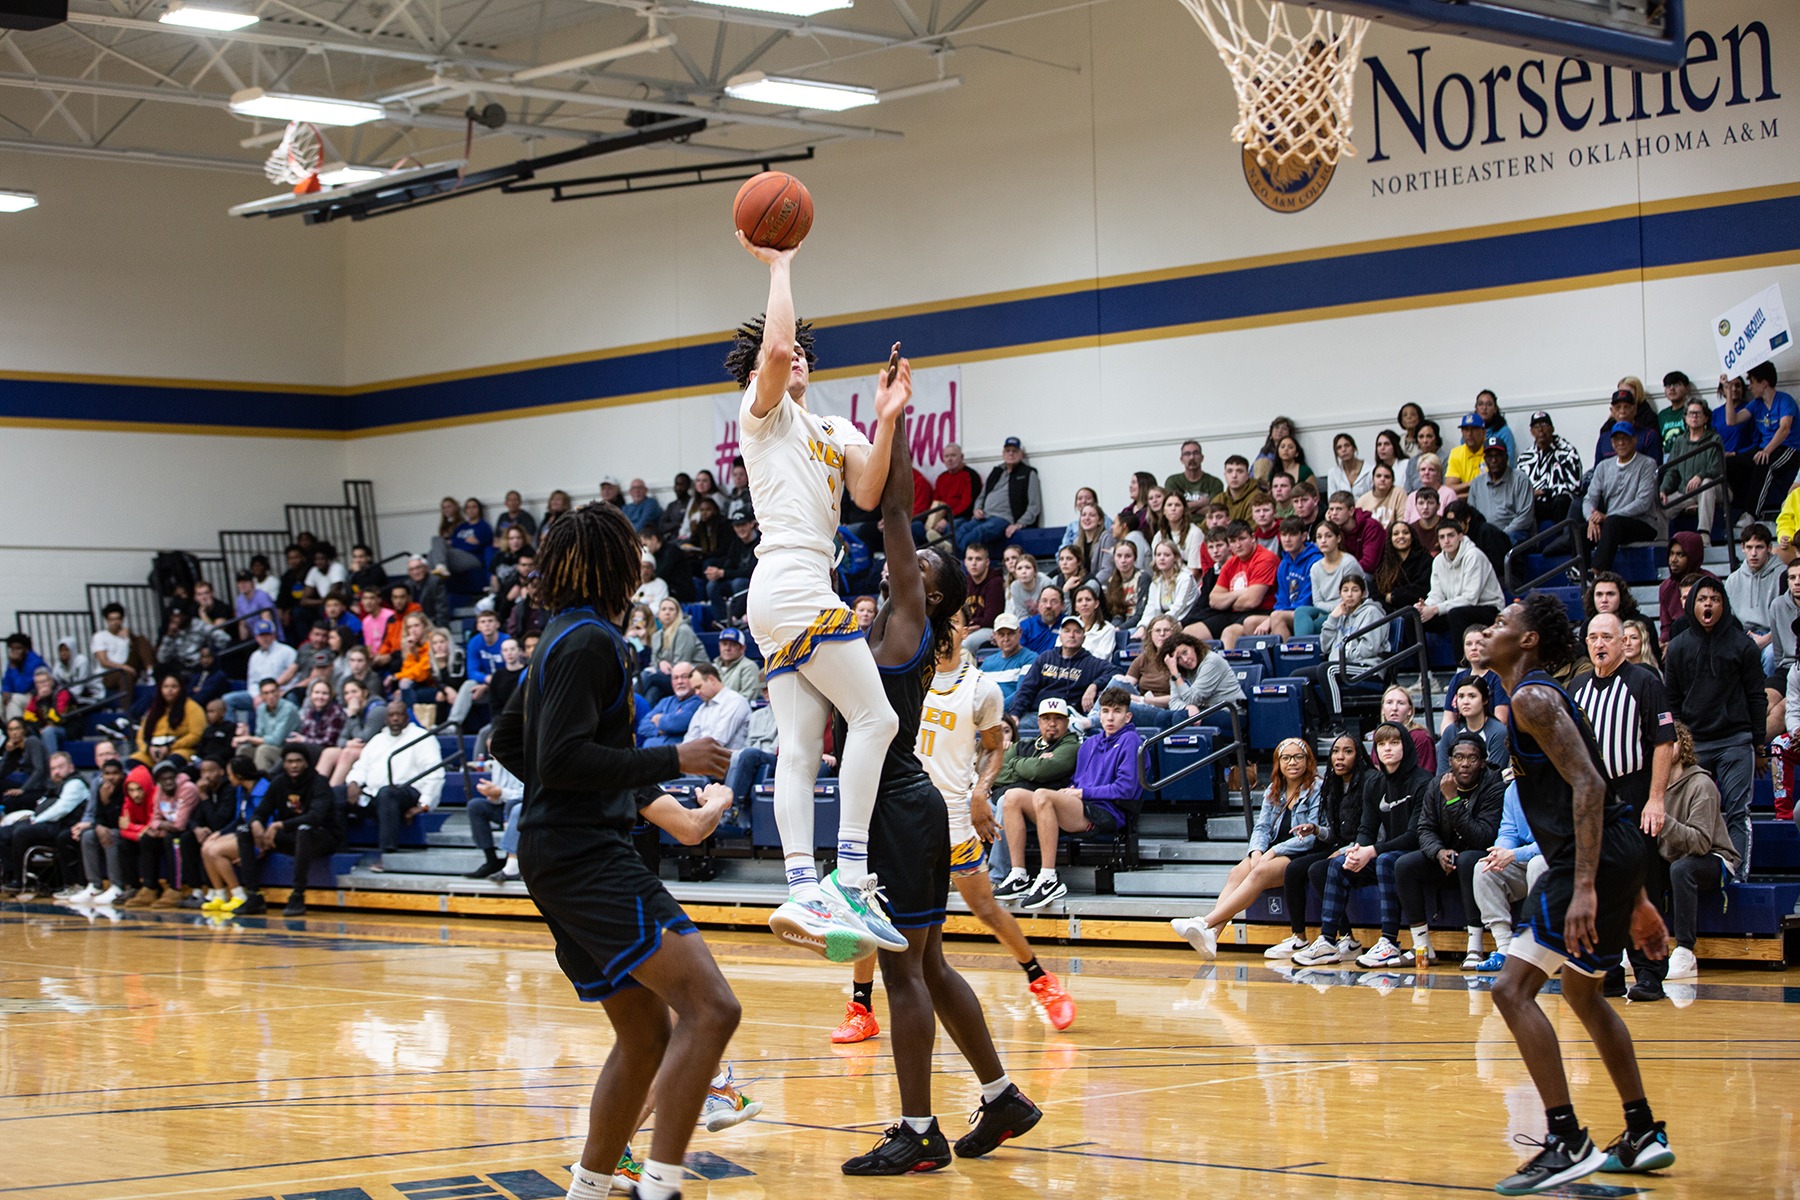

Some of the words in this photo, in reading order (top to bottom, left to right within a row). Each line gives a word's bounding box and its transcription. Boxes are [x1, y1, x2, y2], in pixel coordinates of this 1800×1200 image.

[1370, 151, 1555, 198] NORTHEASTERN
[1568, 129, 1711, 168] OKLAHOMA
[1722, 117, 1780, 146] A&M
[1724, 350, 1736, 369] GO
[1734, 336, 1746, 356] GO
[920, 705, 957, 732] EO
[1047, 701, 1059, 709] W
[921, 728, 936, 757] 11
